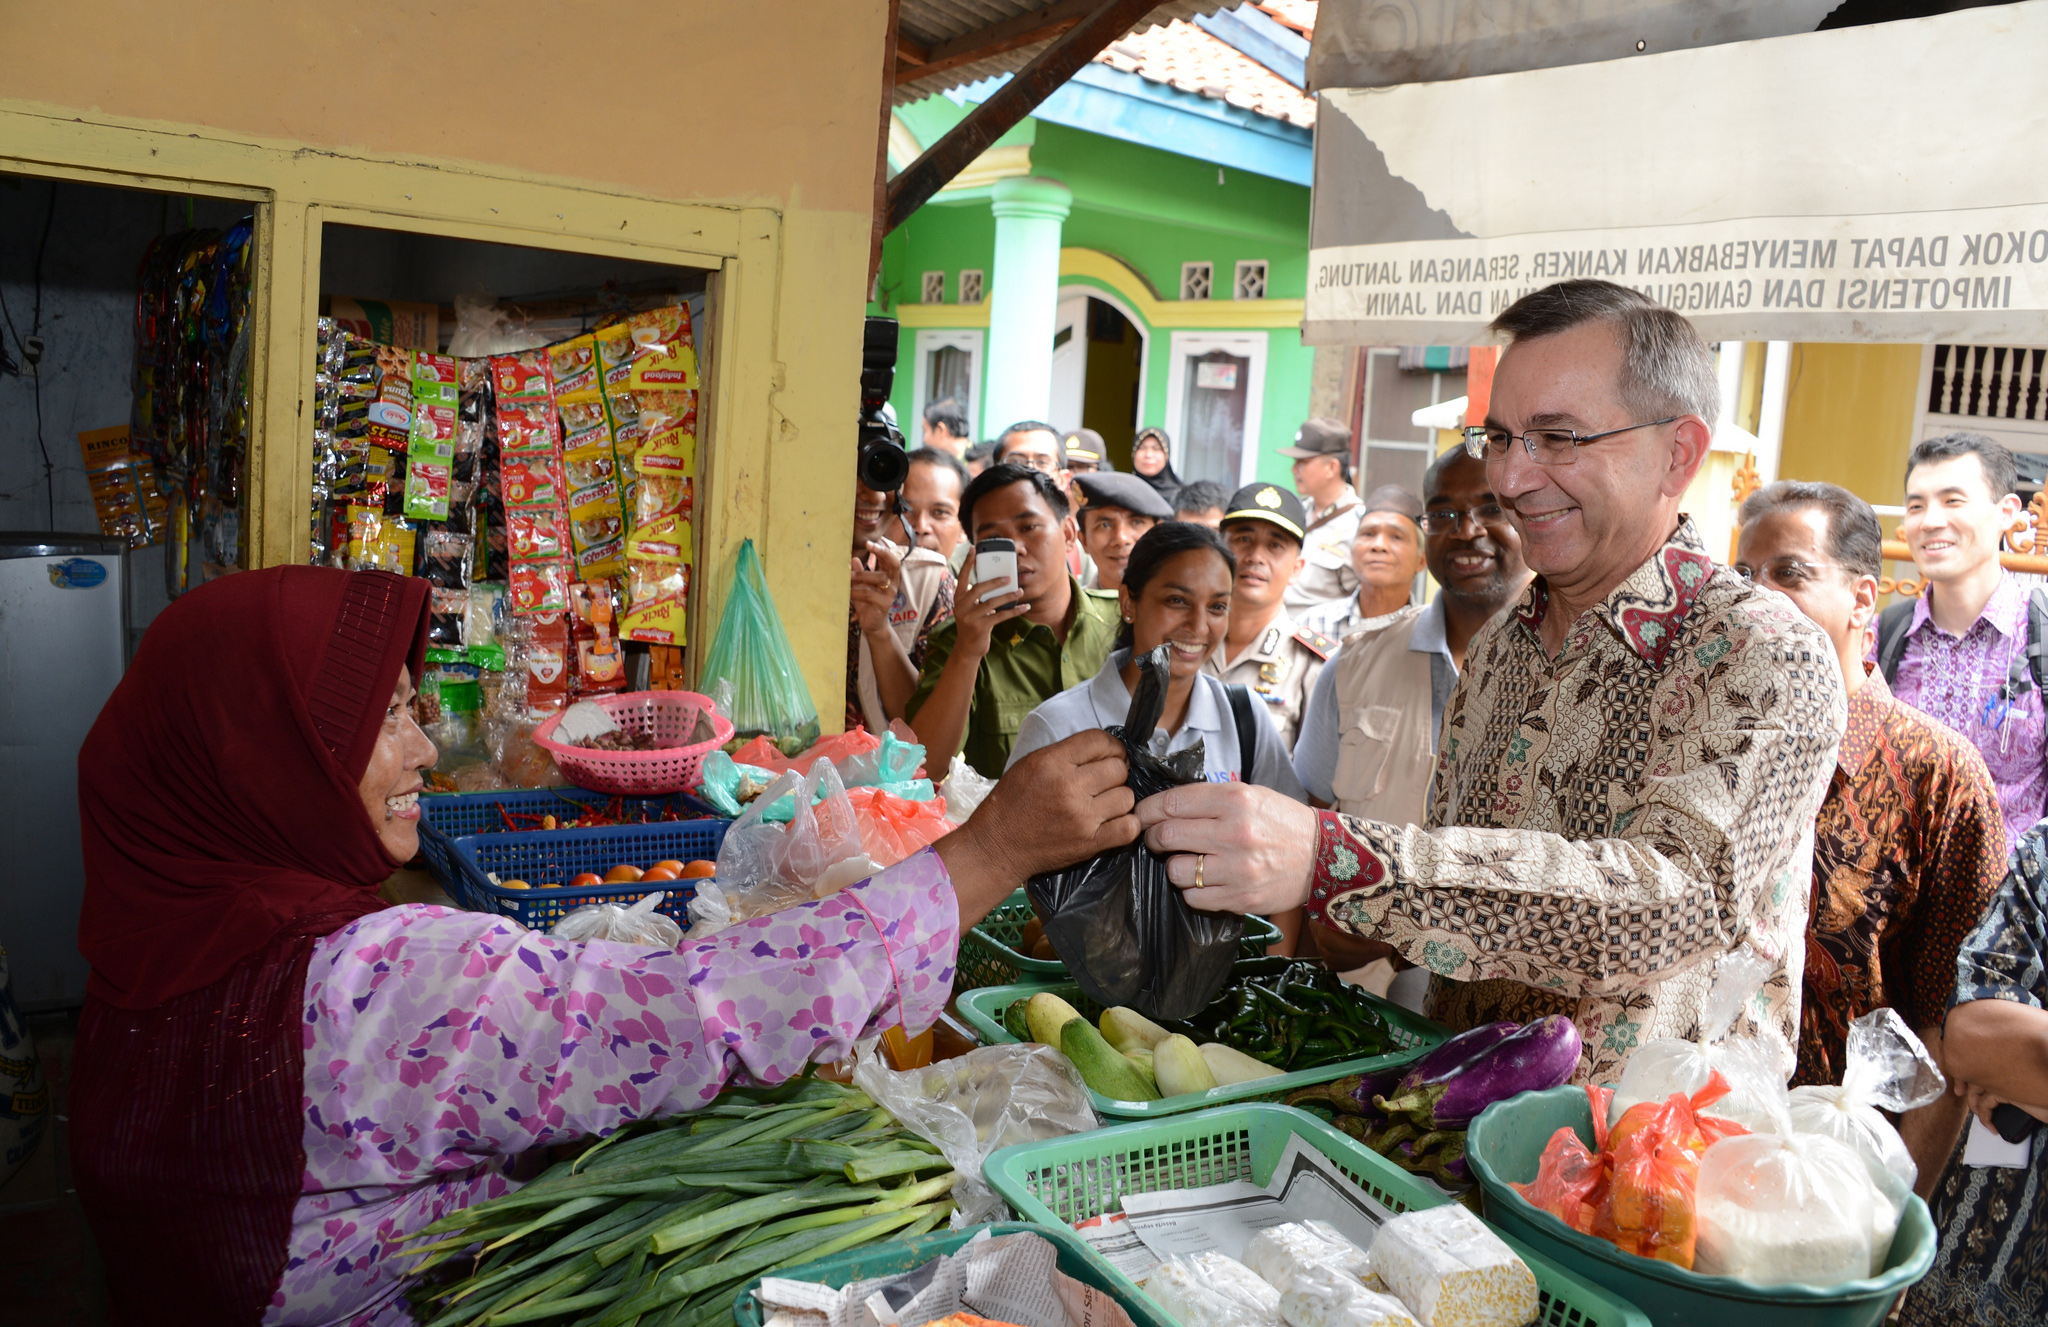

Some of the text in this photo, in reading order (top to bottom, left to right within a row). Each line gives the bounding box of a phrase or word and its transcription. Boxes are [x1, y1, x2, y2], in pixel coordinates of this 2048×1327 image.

[644, 371, 682, 380] Indofood
[87, 437, 128, 451] RINCO
[653, 431, 679, 451] Racik
[583, 540, 622, 564] Masako
[640, 604, 670, 624] Racik
